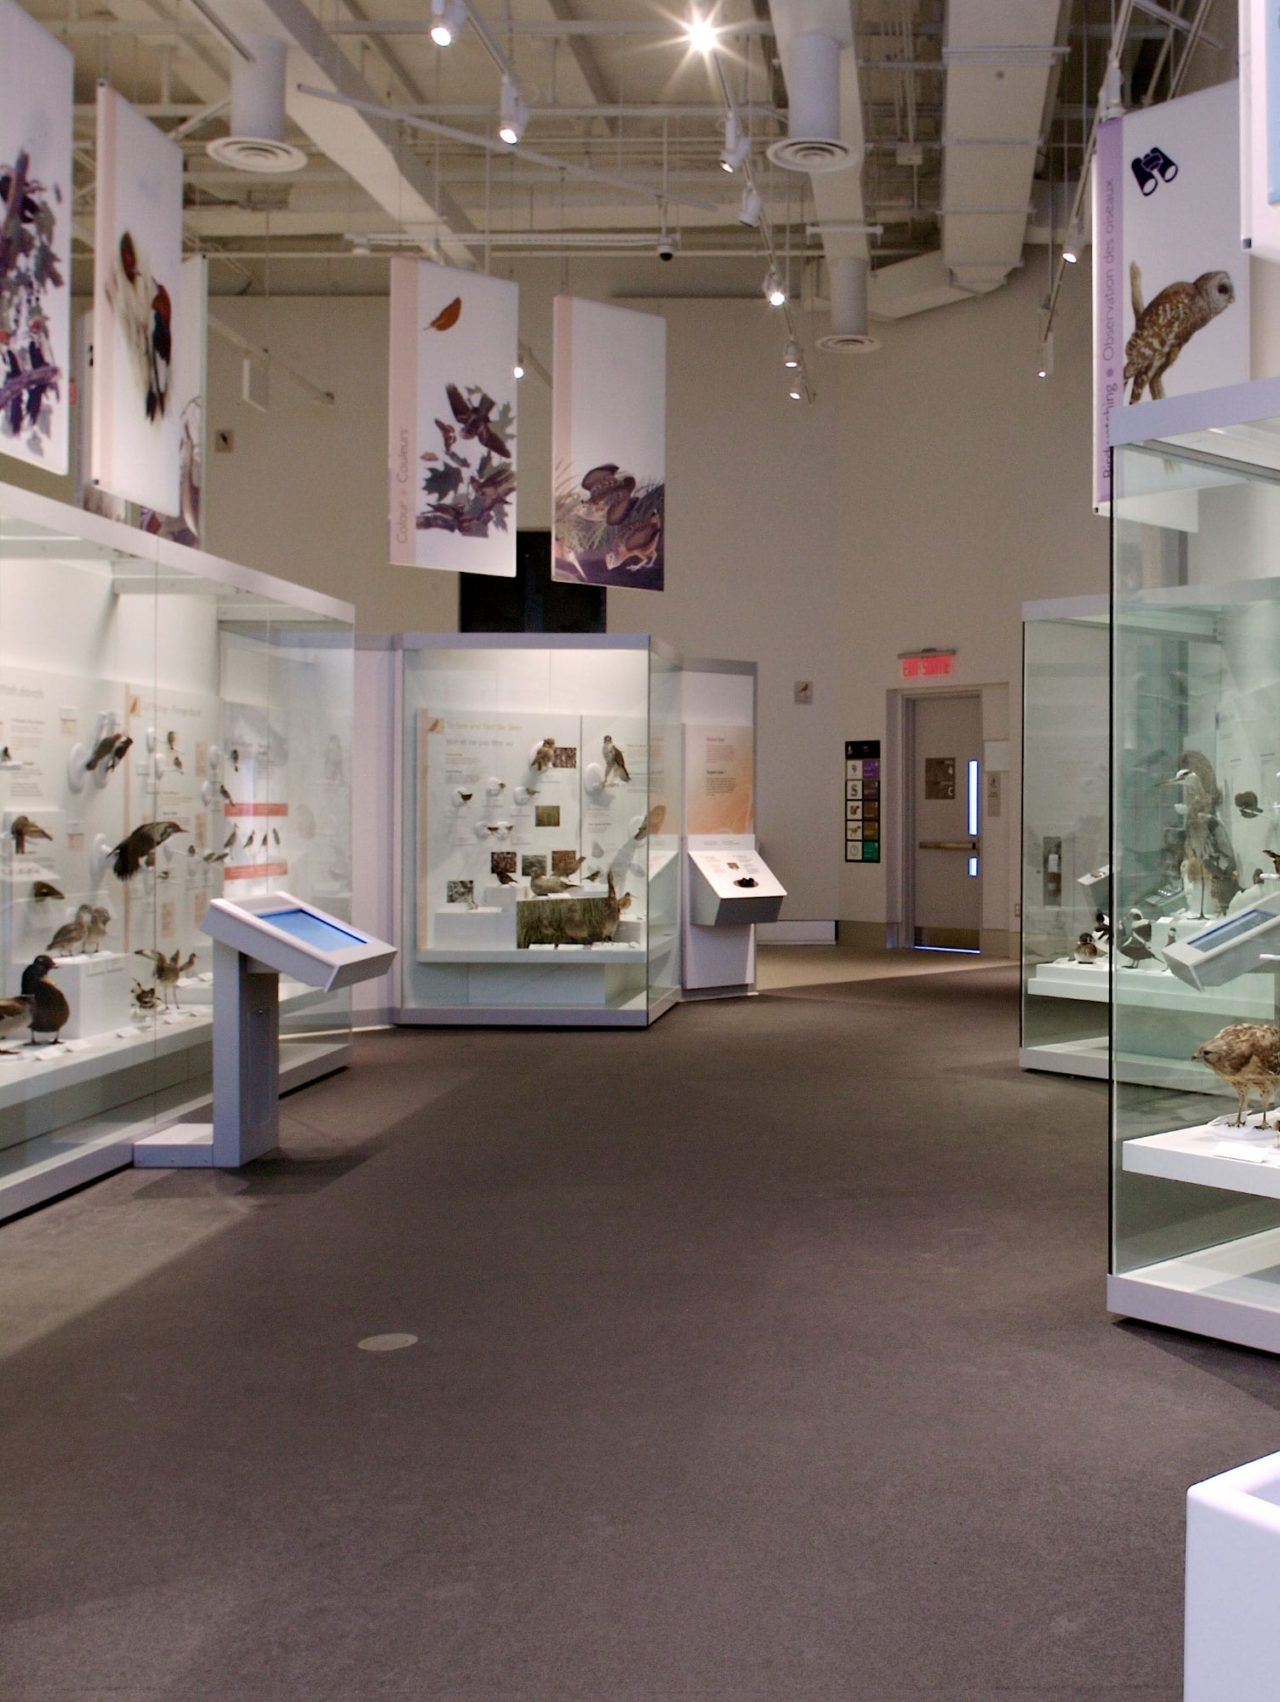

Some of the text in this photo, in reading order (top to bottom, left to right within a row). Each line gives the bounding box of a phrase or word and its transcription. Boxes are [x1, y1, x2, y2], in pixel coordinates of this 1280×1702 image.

[1105, 179, 1115, 234] oiseaux
[1103, 238, 1115, 264] des
[1102, 268, 1115, 361] Observation
